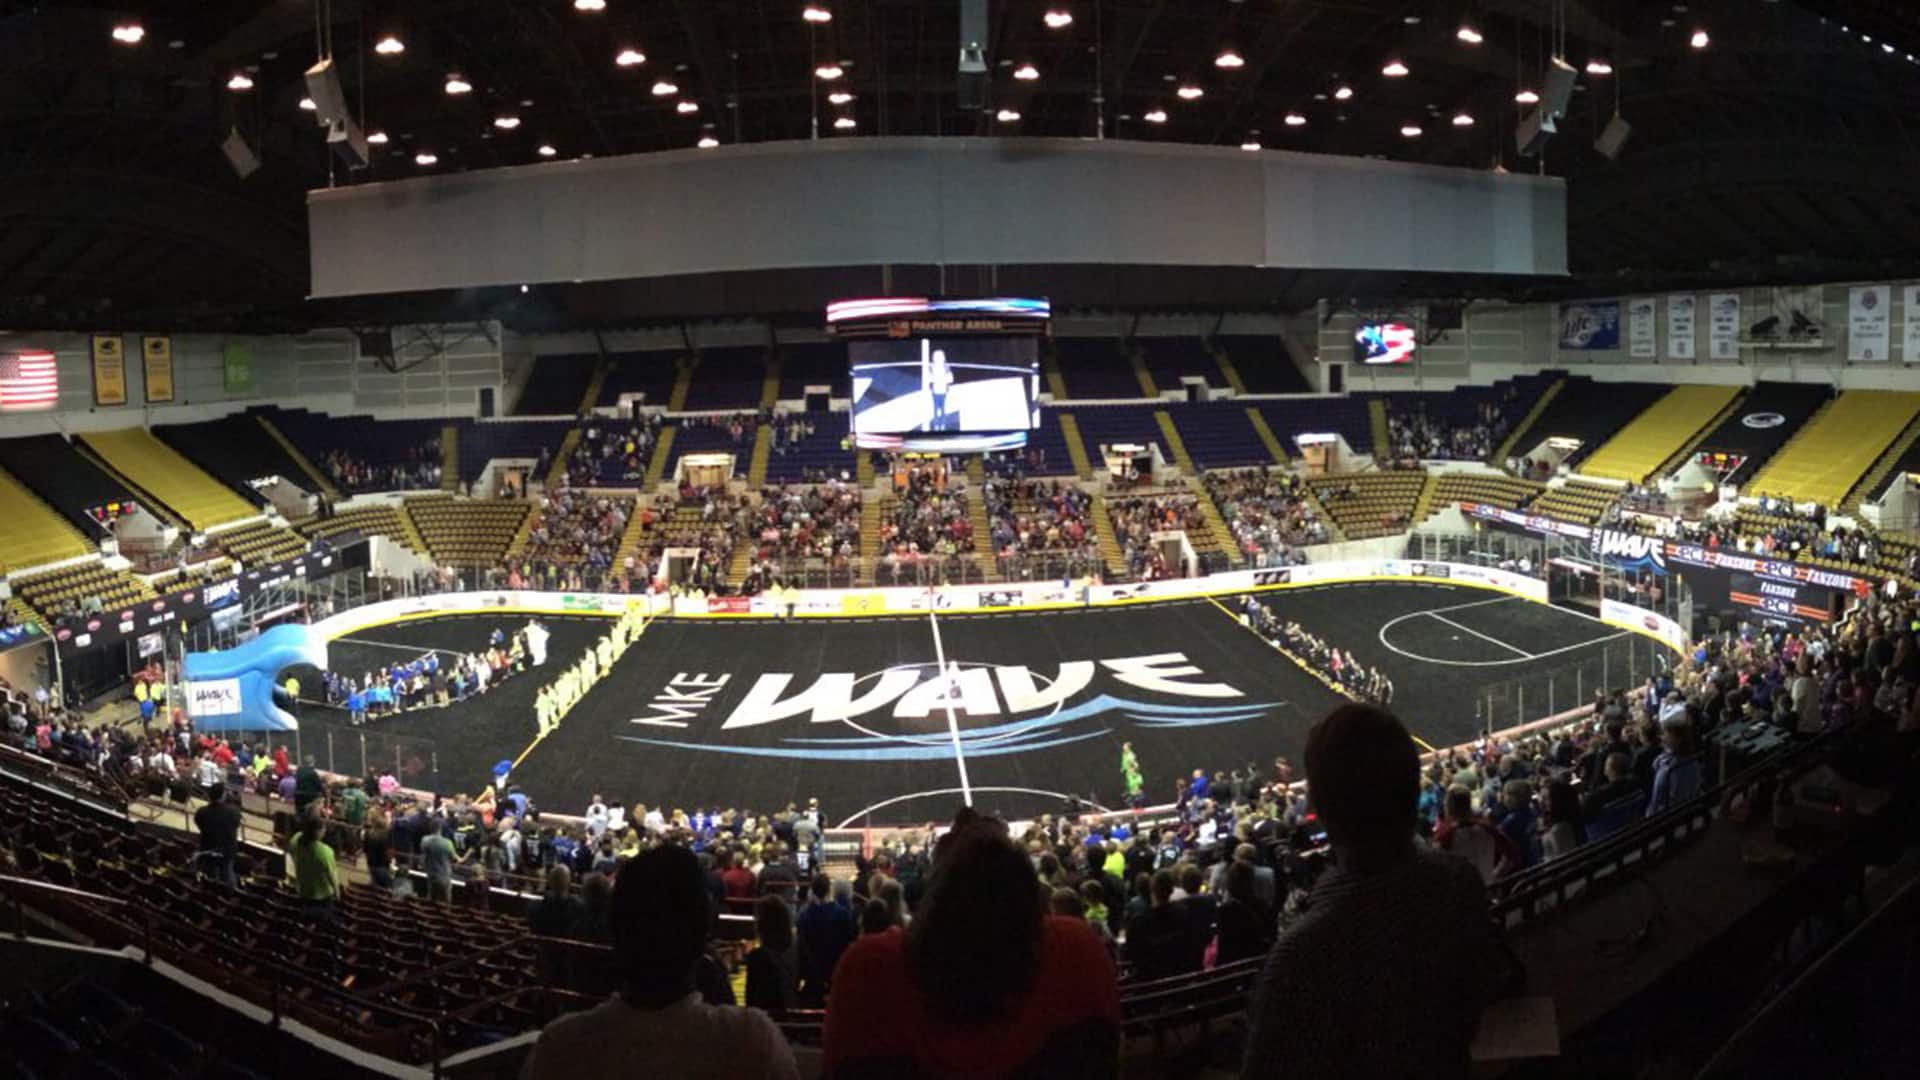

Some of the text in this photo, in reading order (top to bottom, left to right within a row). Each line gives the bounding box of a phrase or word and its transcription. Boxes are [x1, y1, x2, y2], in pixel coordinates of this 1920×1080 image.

[1602, 529, 1665, 567] WAVE
[1806, 568, 1853, 590] FANZONE
[631, 672, 732, 728] MKE
[721, 652, 1246, 730] WAVE
